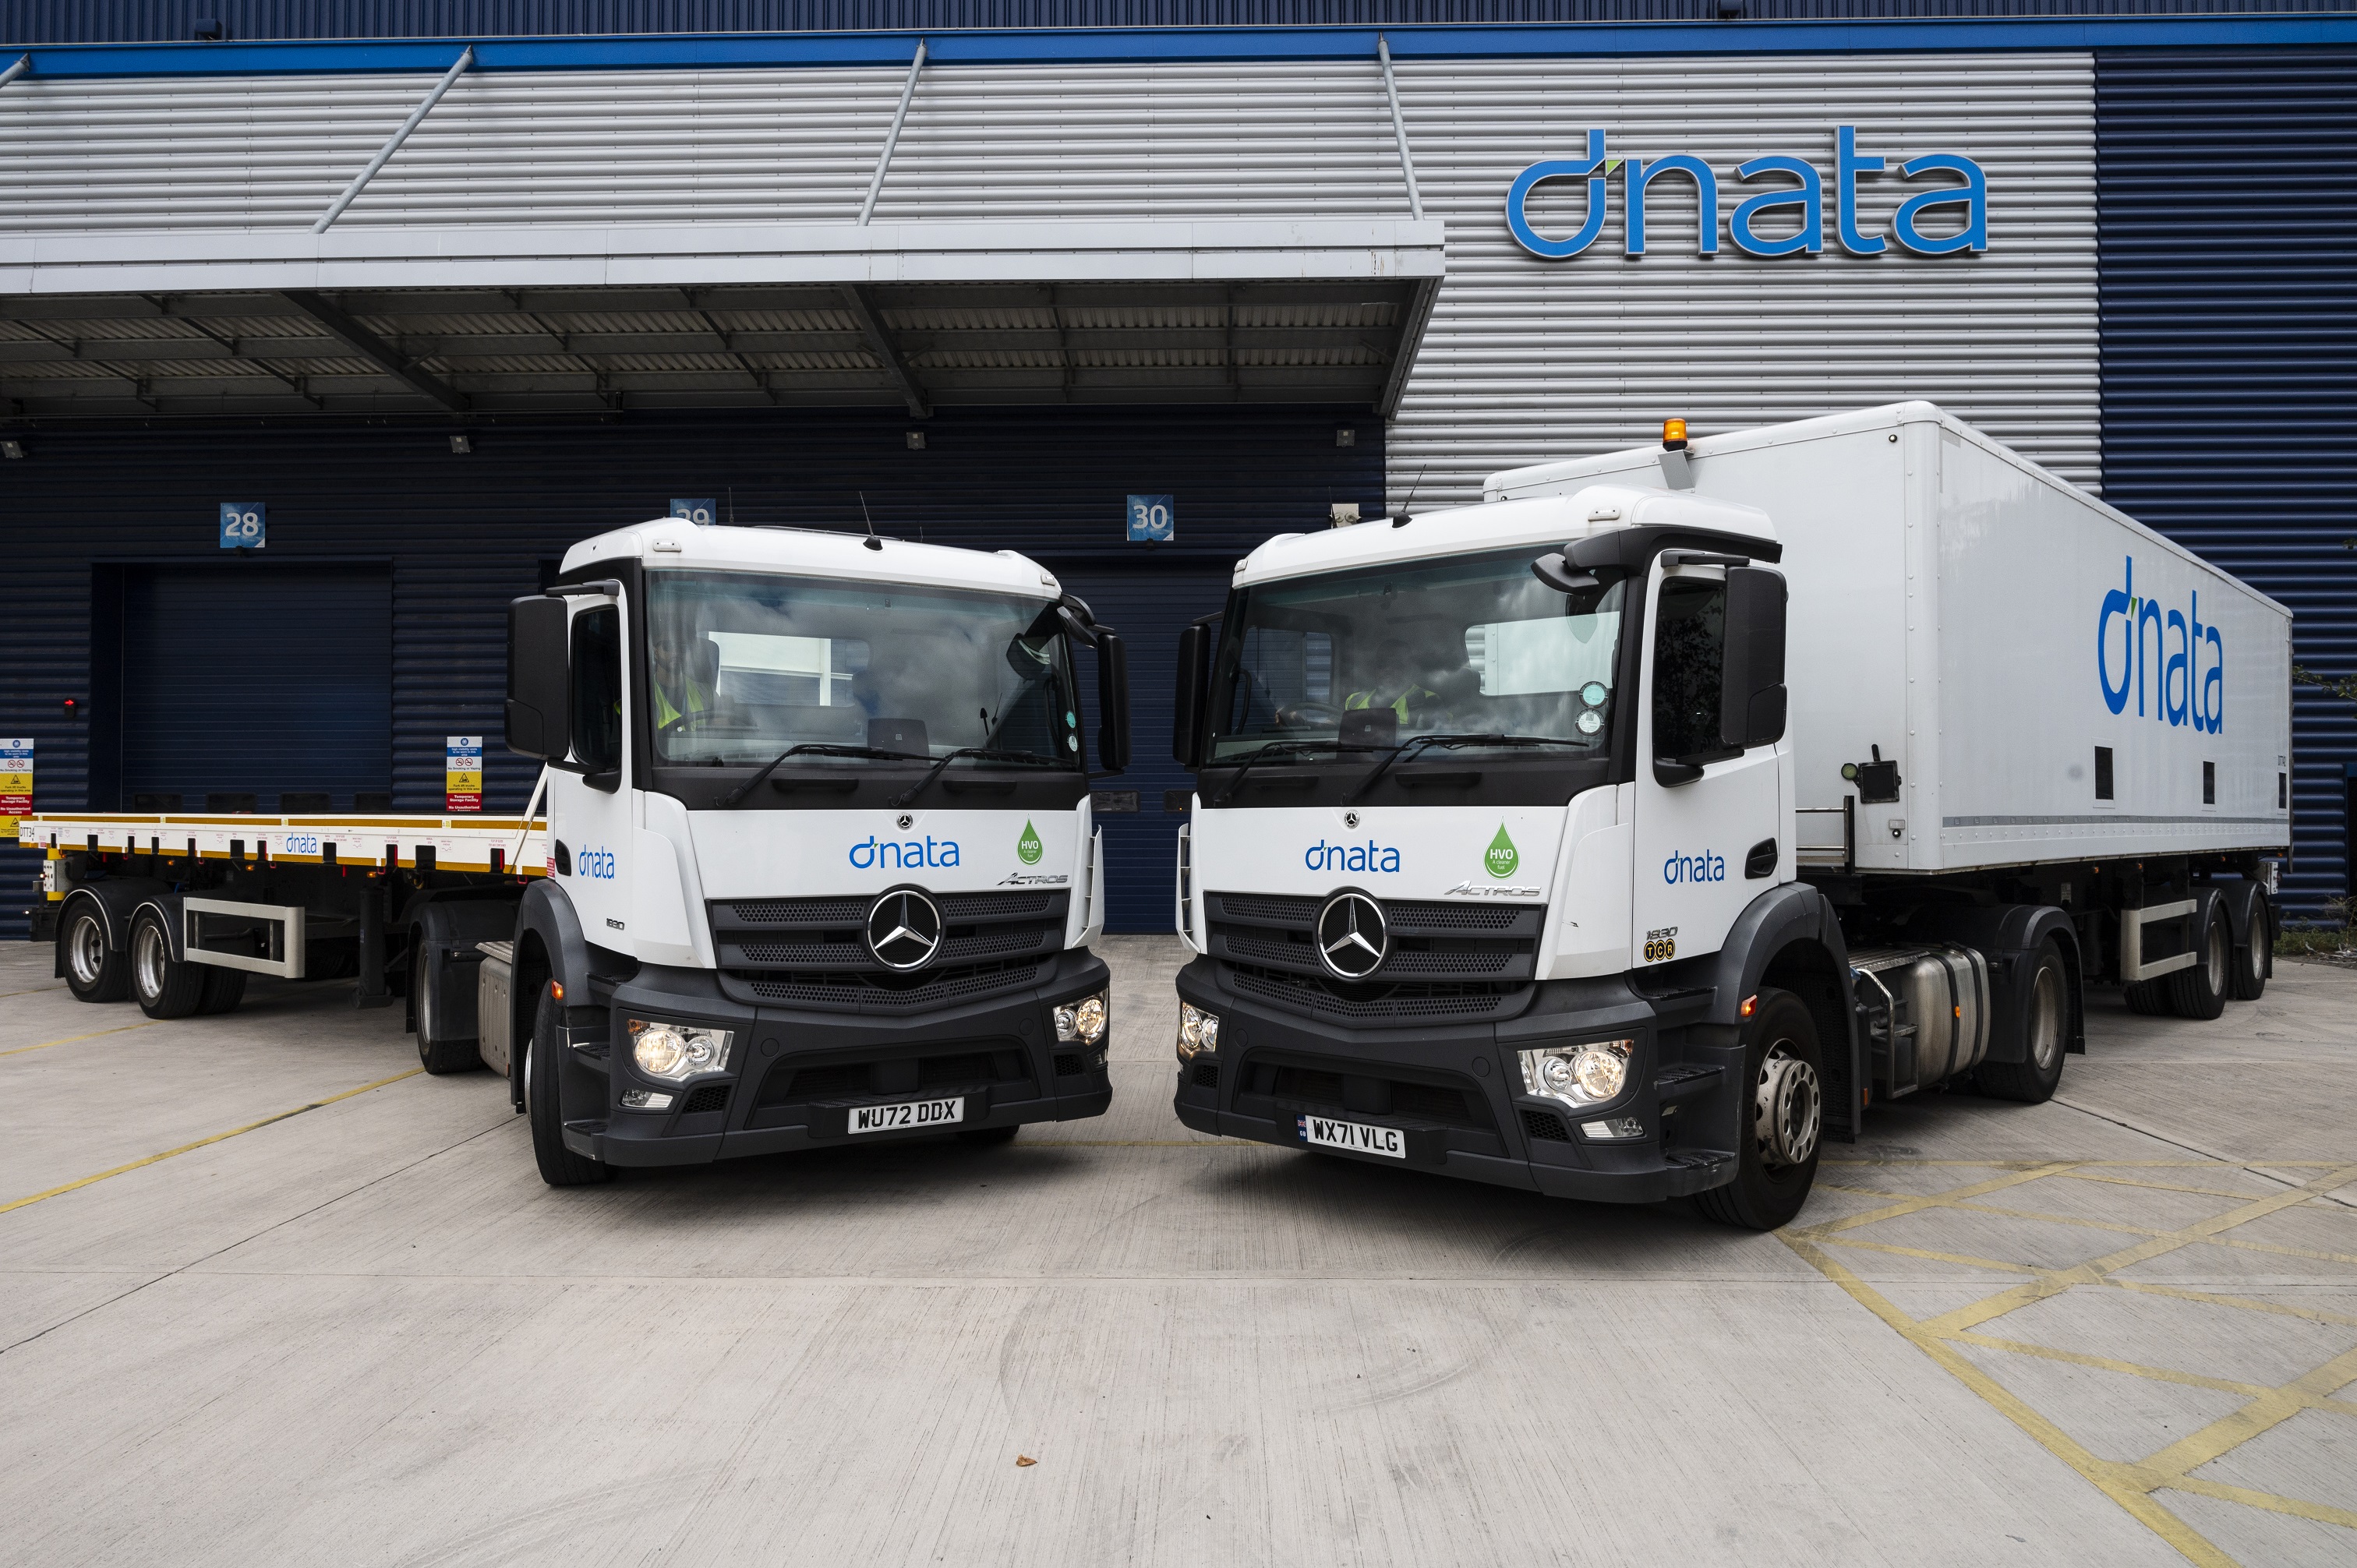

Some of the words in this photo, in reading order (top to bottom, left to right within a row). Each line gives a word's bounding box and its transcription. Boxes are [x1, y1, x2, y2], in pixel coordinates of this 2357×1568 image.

[1505, 125, 1988, 259] dnata
[225, 512, 258, 536] 28
[1133, 504, 1168, 529] 30
[2097, 555, 2222, 735] dnata
[286, 832, 316, 853] dnata
[849, 835, 959, 869] dnata
[1021, 840, 1039, 849] HVO
[1489, 849, 1514, 860] HVO
[579, 844, 614, 879] dnata
[1306, 839, 1400, 873] dnata
[1664, 849, 1724, 885] dnata
[996, 872, 1069, 885] ACTROS
[1444, 880, 1542, 896] ACTROS
[1646, 927, 1678, 940] 1830
[858, 1105, 911, 1128] WU72
[917, 1100, 956, 1122] DDX
[1313, 1119, 1355, 1146] WX71
[1359, 1126, 1398, 1152] VLG
